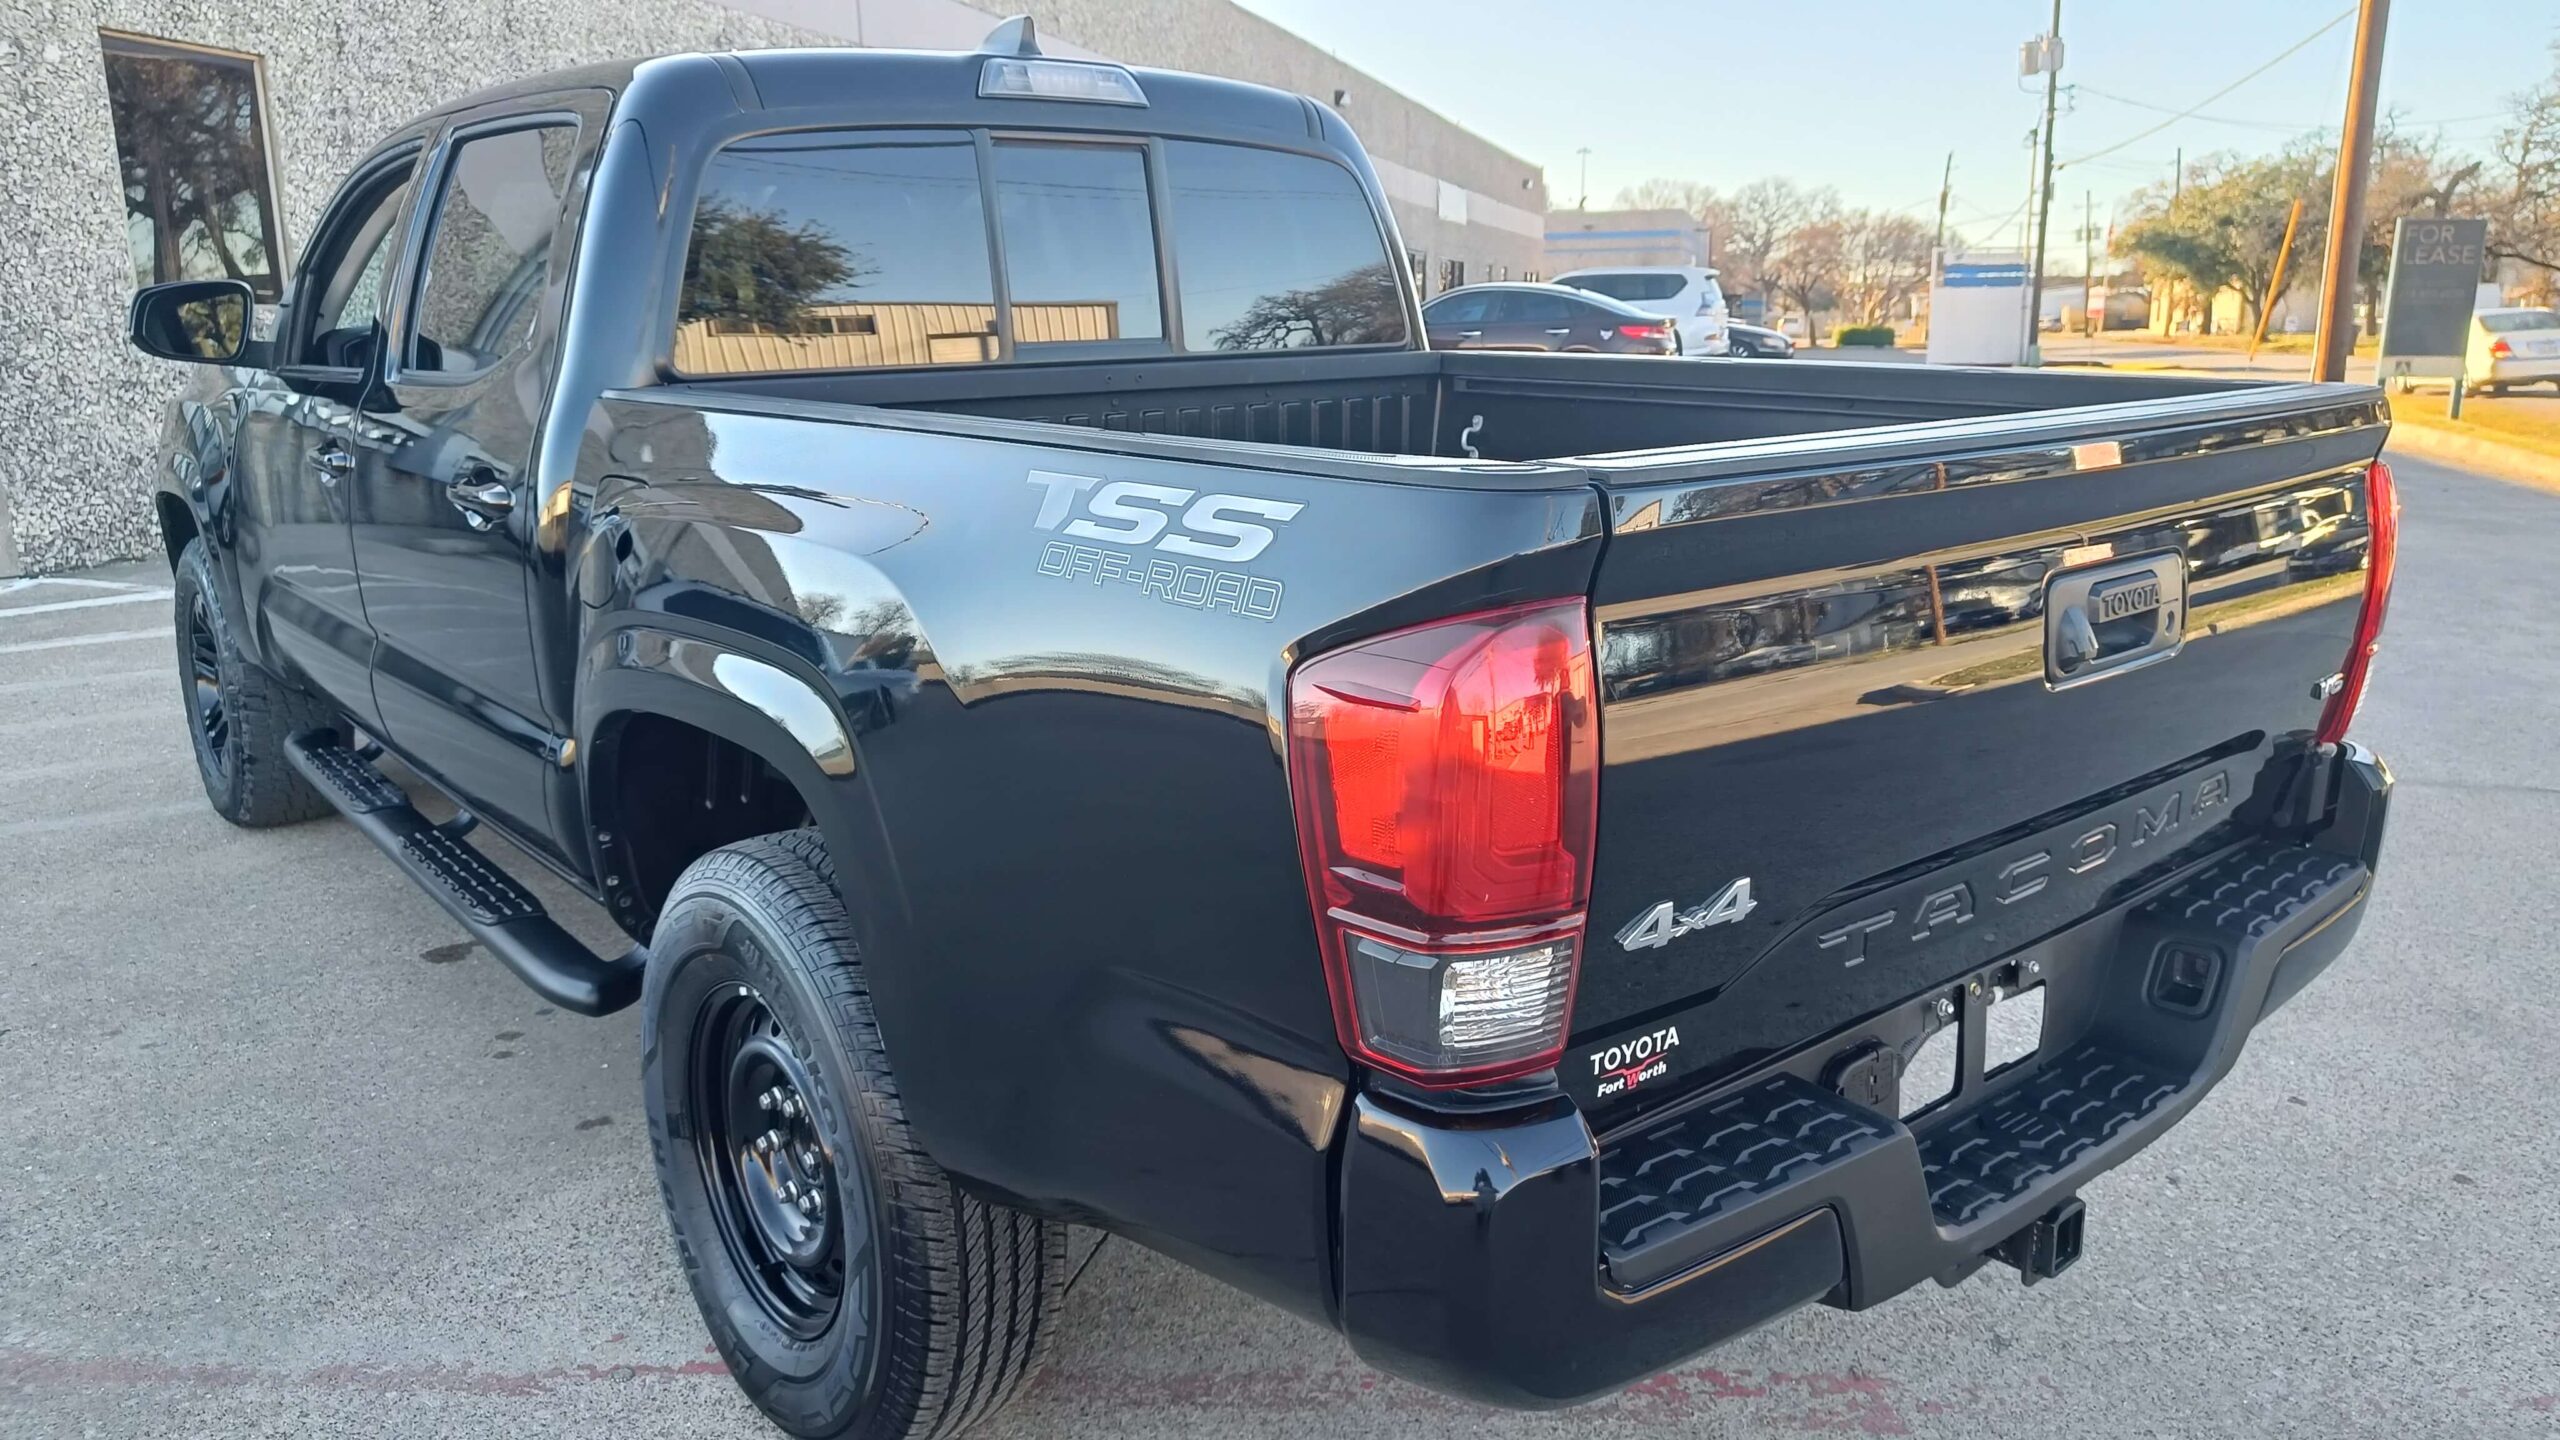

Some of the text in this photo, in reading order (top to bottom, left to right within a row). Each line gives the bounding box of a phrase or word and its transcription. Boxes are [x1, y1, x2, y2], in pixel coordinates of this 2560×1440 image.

[2402, 244, 2476, 265] LEASE
[2405, 224, 2455, 244] FOR
[1027, 470, 1306, 563] TSS
[1037, 541, 1284, 620] OFF-ROAD
[2102, 583, 2161, 618] TOYOTA
[1817, 769, 2230, 968] TACOMA
[1590, 1026, 1680, 1076] TOYOTA
[1597, 1061, 1667, 1098] Fort Worth
